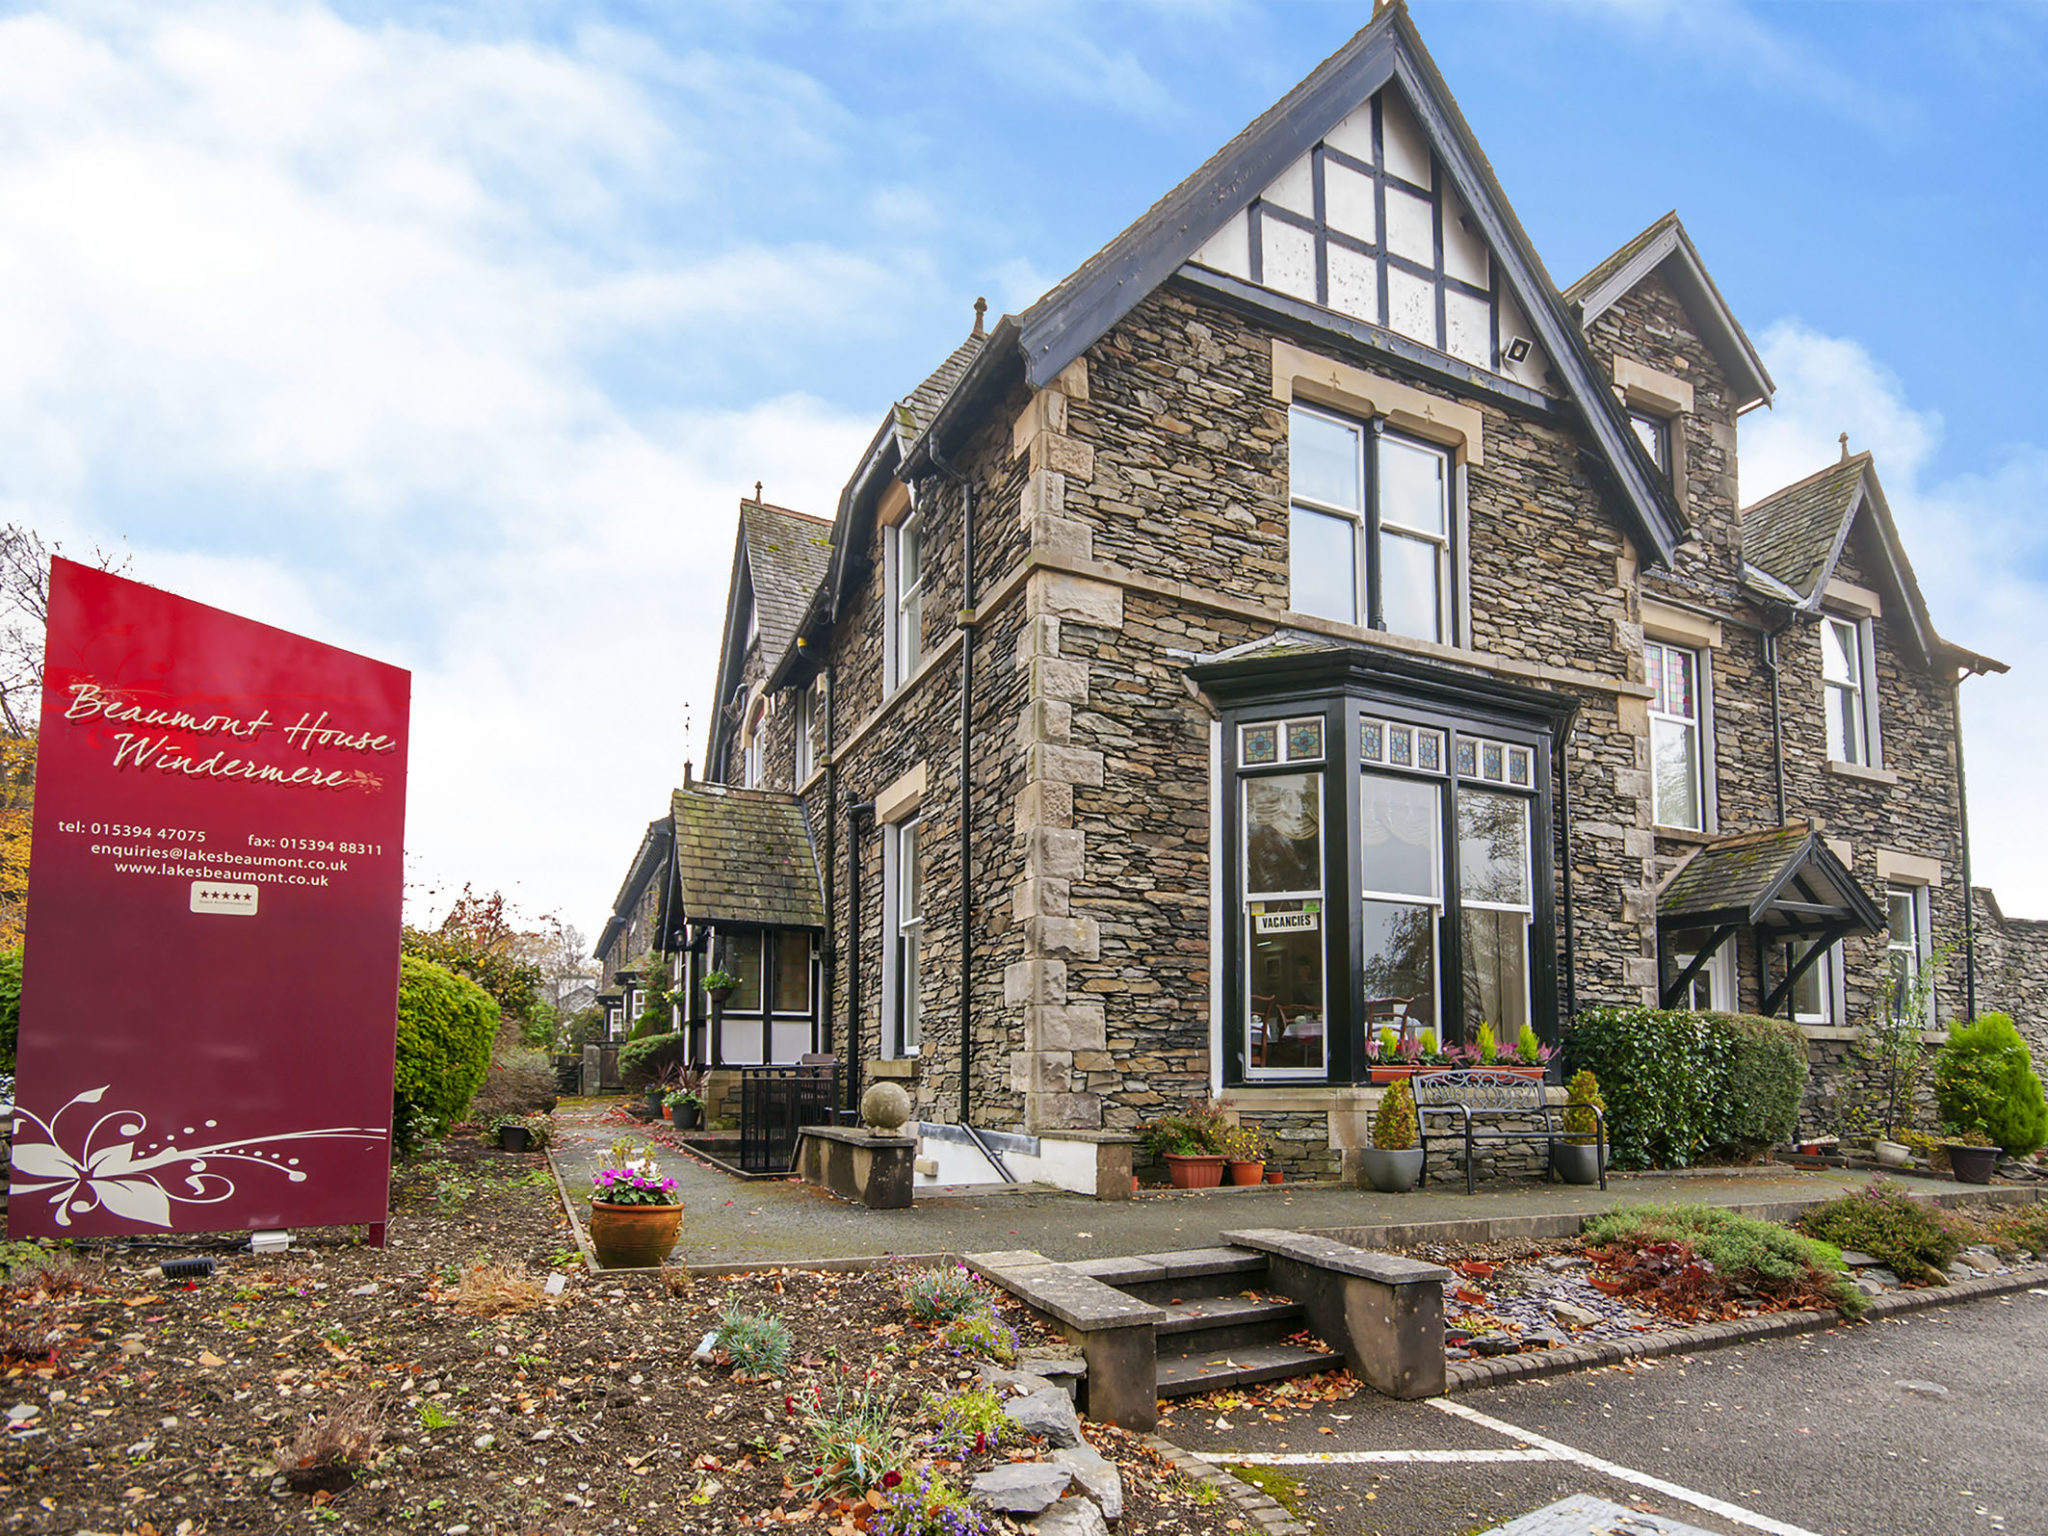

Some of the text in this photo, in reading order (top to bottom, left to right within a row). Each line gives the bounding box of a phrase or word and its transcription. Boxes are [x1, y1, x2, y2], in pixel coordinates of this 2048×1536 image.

[64, 683, 396, 751] Beaumont House
[112, 733, 351, 787] Windermere
[58, 820, 206, 843] tel: 015394 47075
[90, 843, 348, 872] enquiries@lakesbeaumont.co.uk
[247, 834, 383, 856] fax: 015394 88311
[114, 862, 329, 887] www.lakesbeaumont.co.uk
[1262, 914, 1311, 929] VACANCIES
